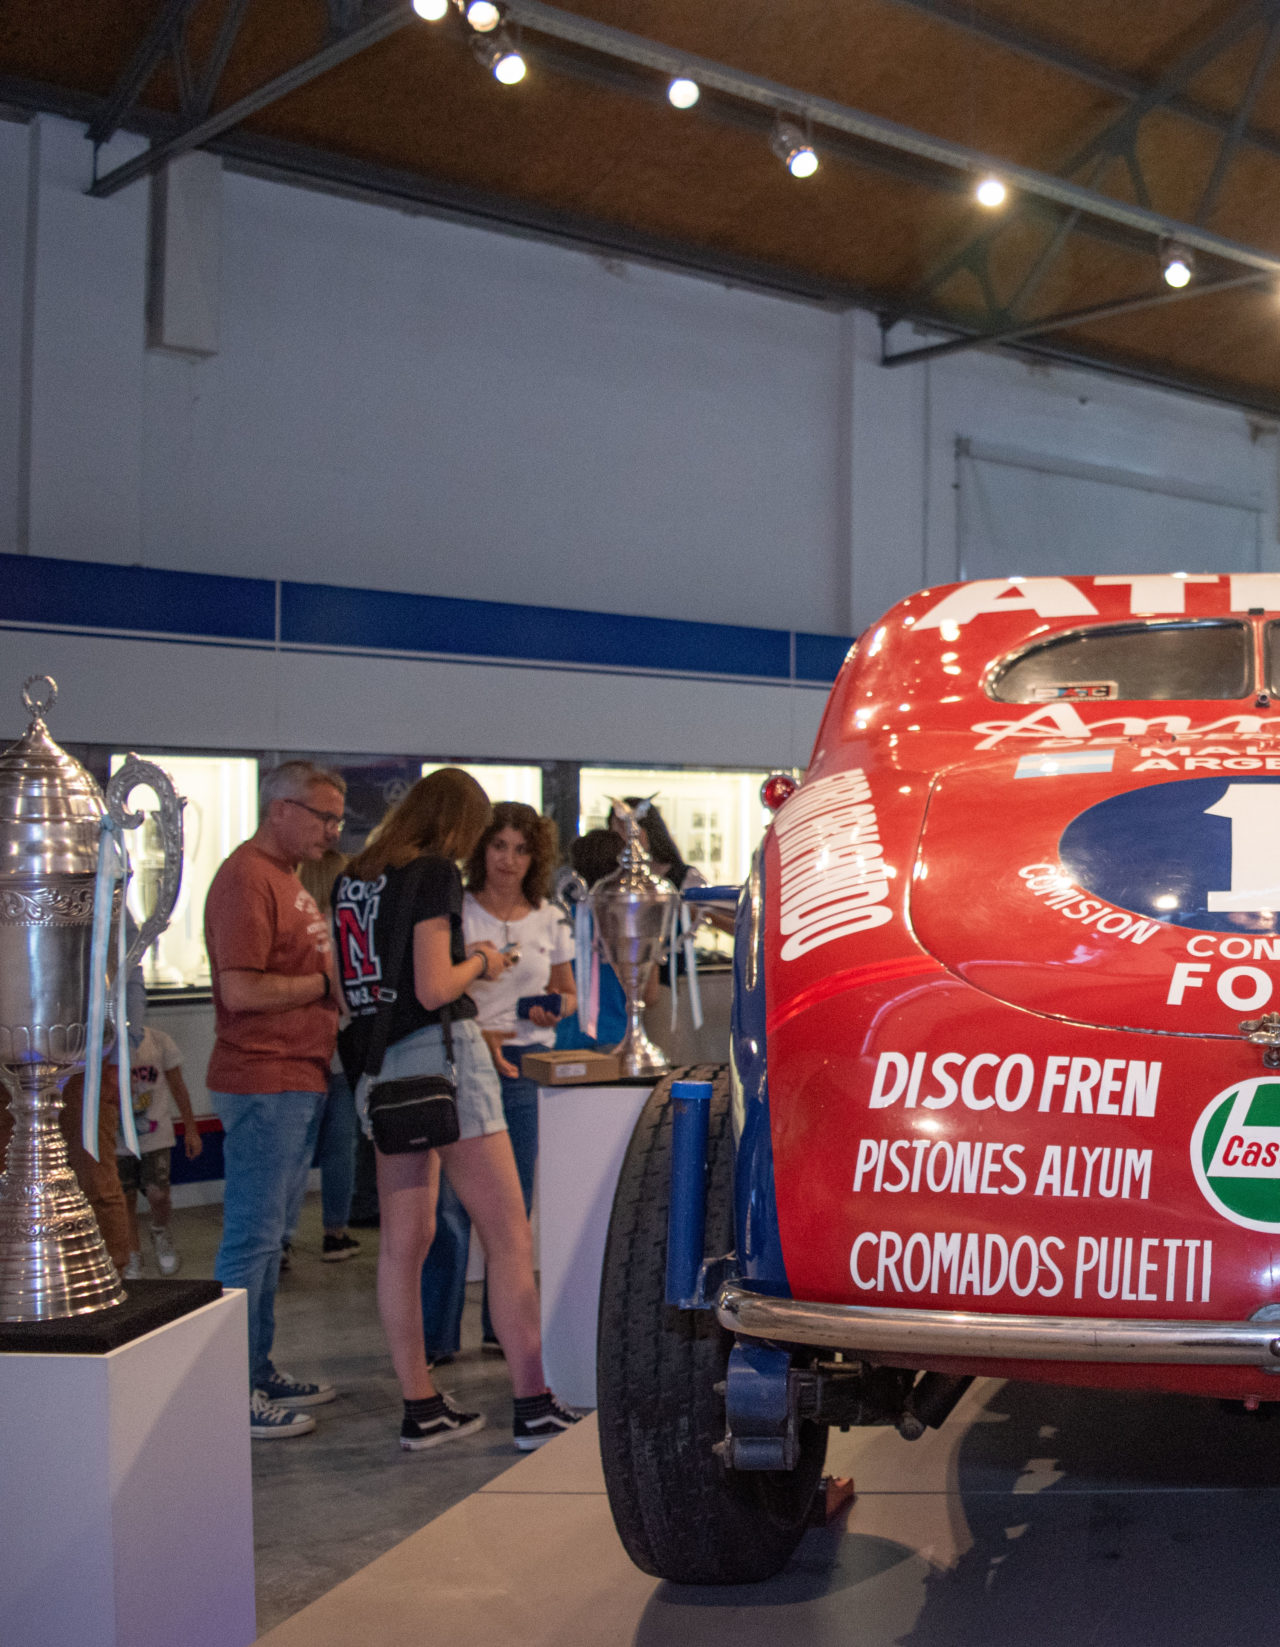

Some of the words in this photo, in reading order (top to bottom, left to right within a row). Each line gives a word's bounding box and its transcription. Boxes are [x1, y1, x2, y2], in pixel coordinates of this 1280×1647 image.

[1018, 862, 1161, 945] COMISION
[852, 1138, 1027, 1196] PISTONES
[1033, 1144, 1154, 1200] ALYUM
[849, 1230, 1066, 1298] CROMADOS
[1073, 1236, 1213, 1303] PULETTI
